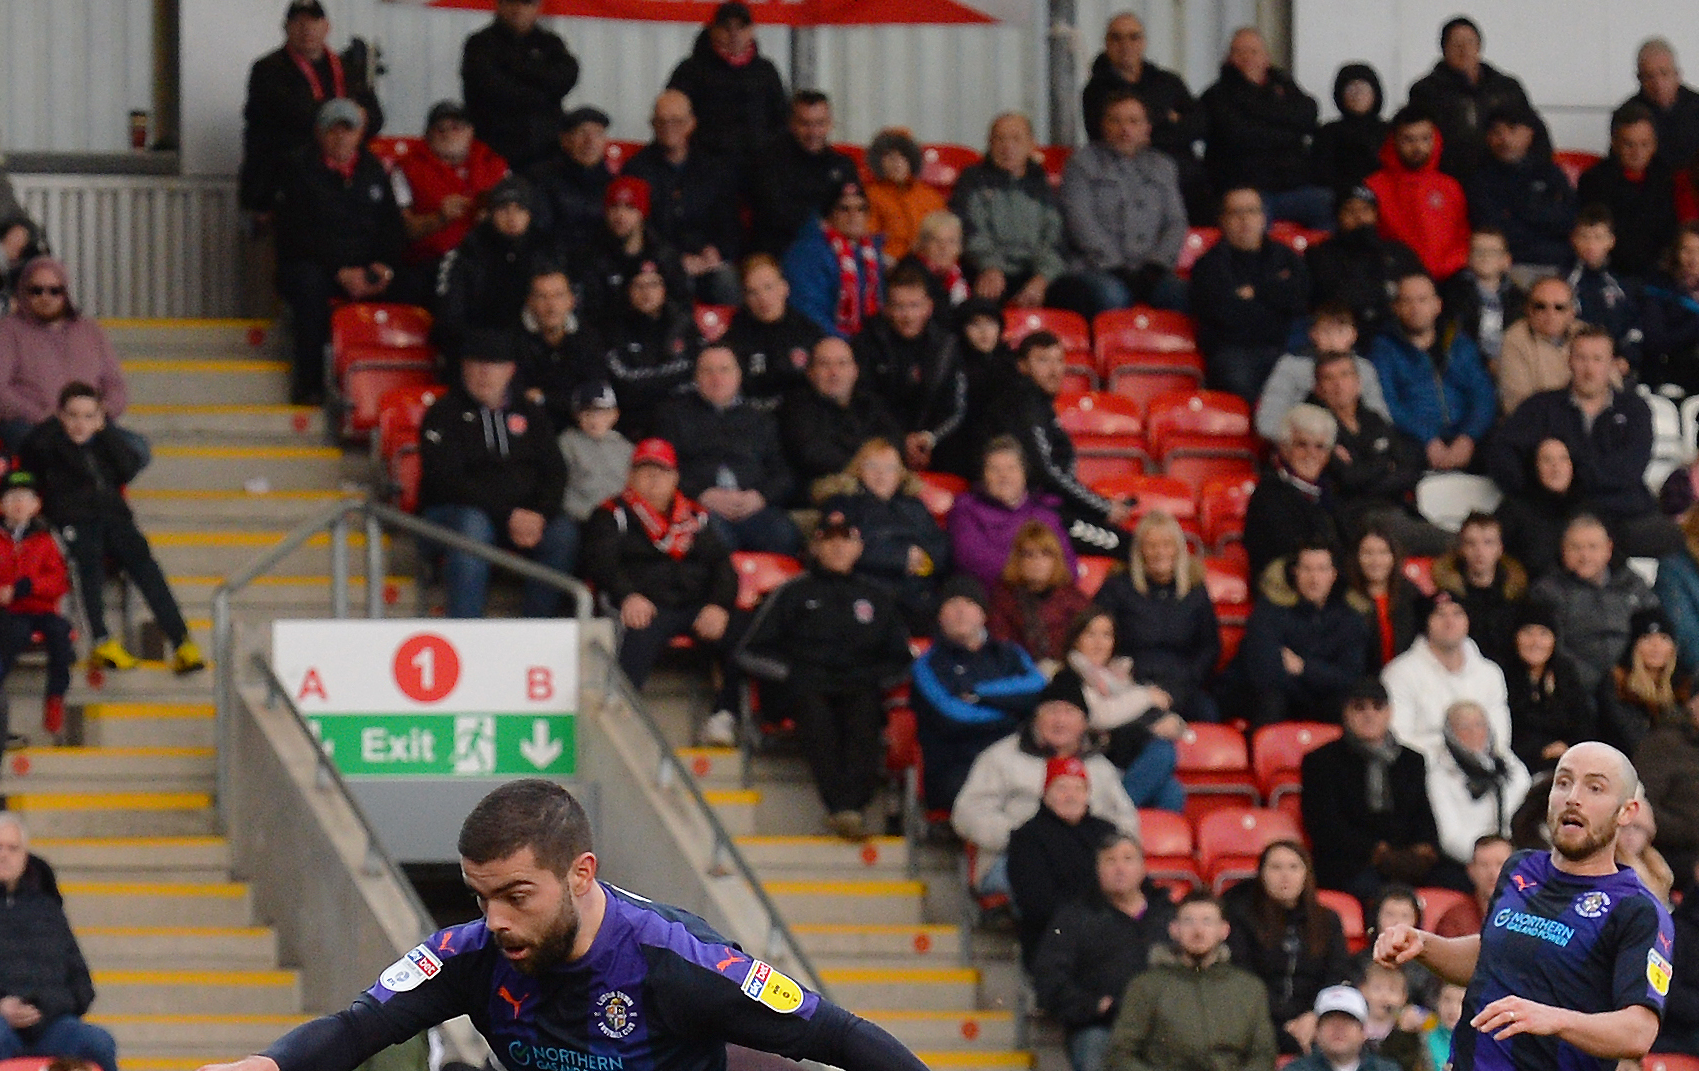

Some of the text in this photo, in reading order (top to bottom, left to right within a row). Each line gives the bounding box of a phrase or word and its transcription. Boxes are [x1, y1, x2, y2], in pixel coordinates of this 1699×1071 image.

[298, 646, 554, 700] A 1 B
[360, 727, 437, 764] Exit
[532, 1046, 624, 1070] NORTHERN
[536, 1060, 559, 1071] GAS
